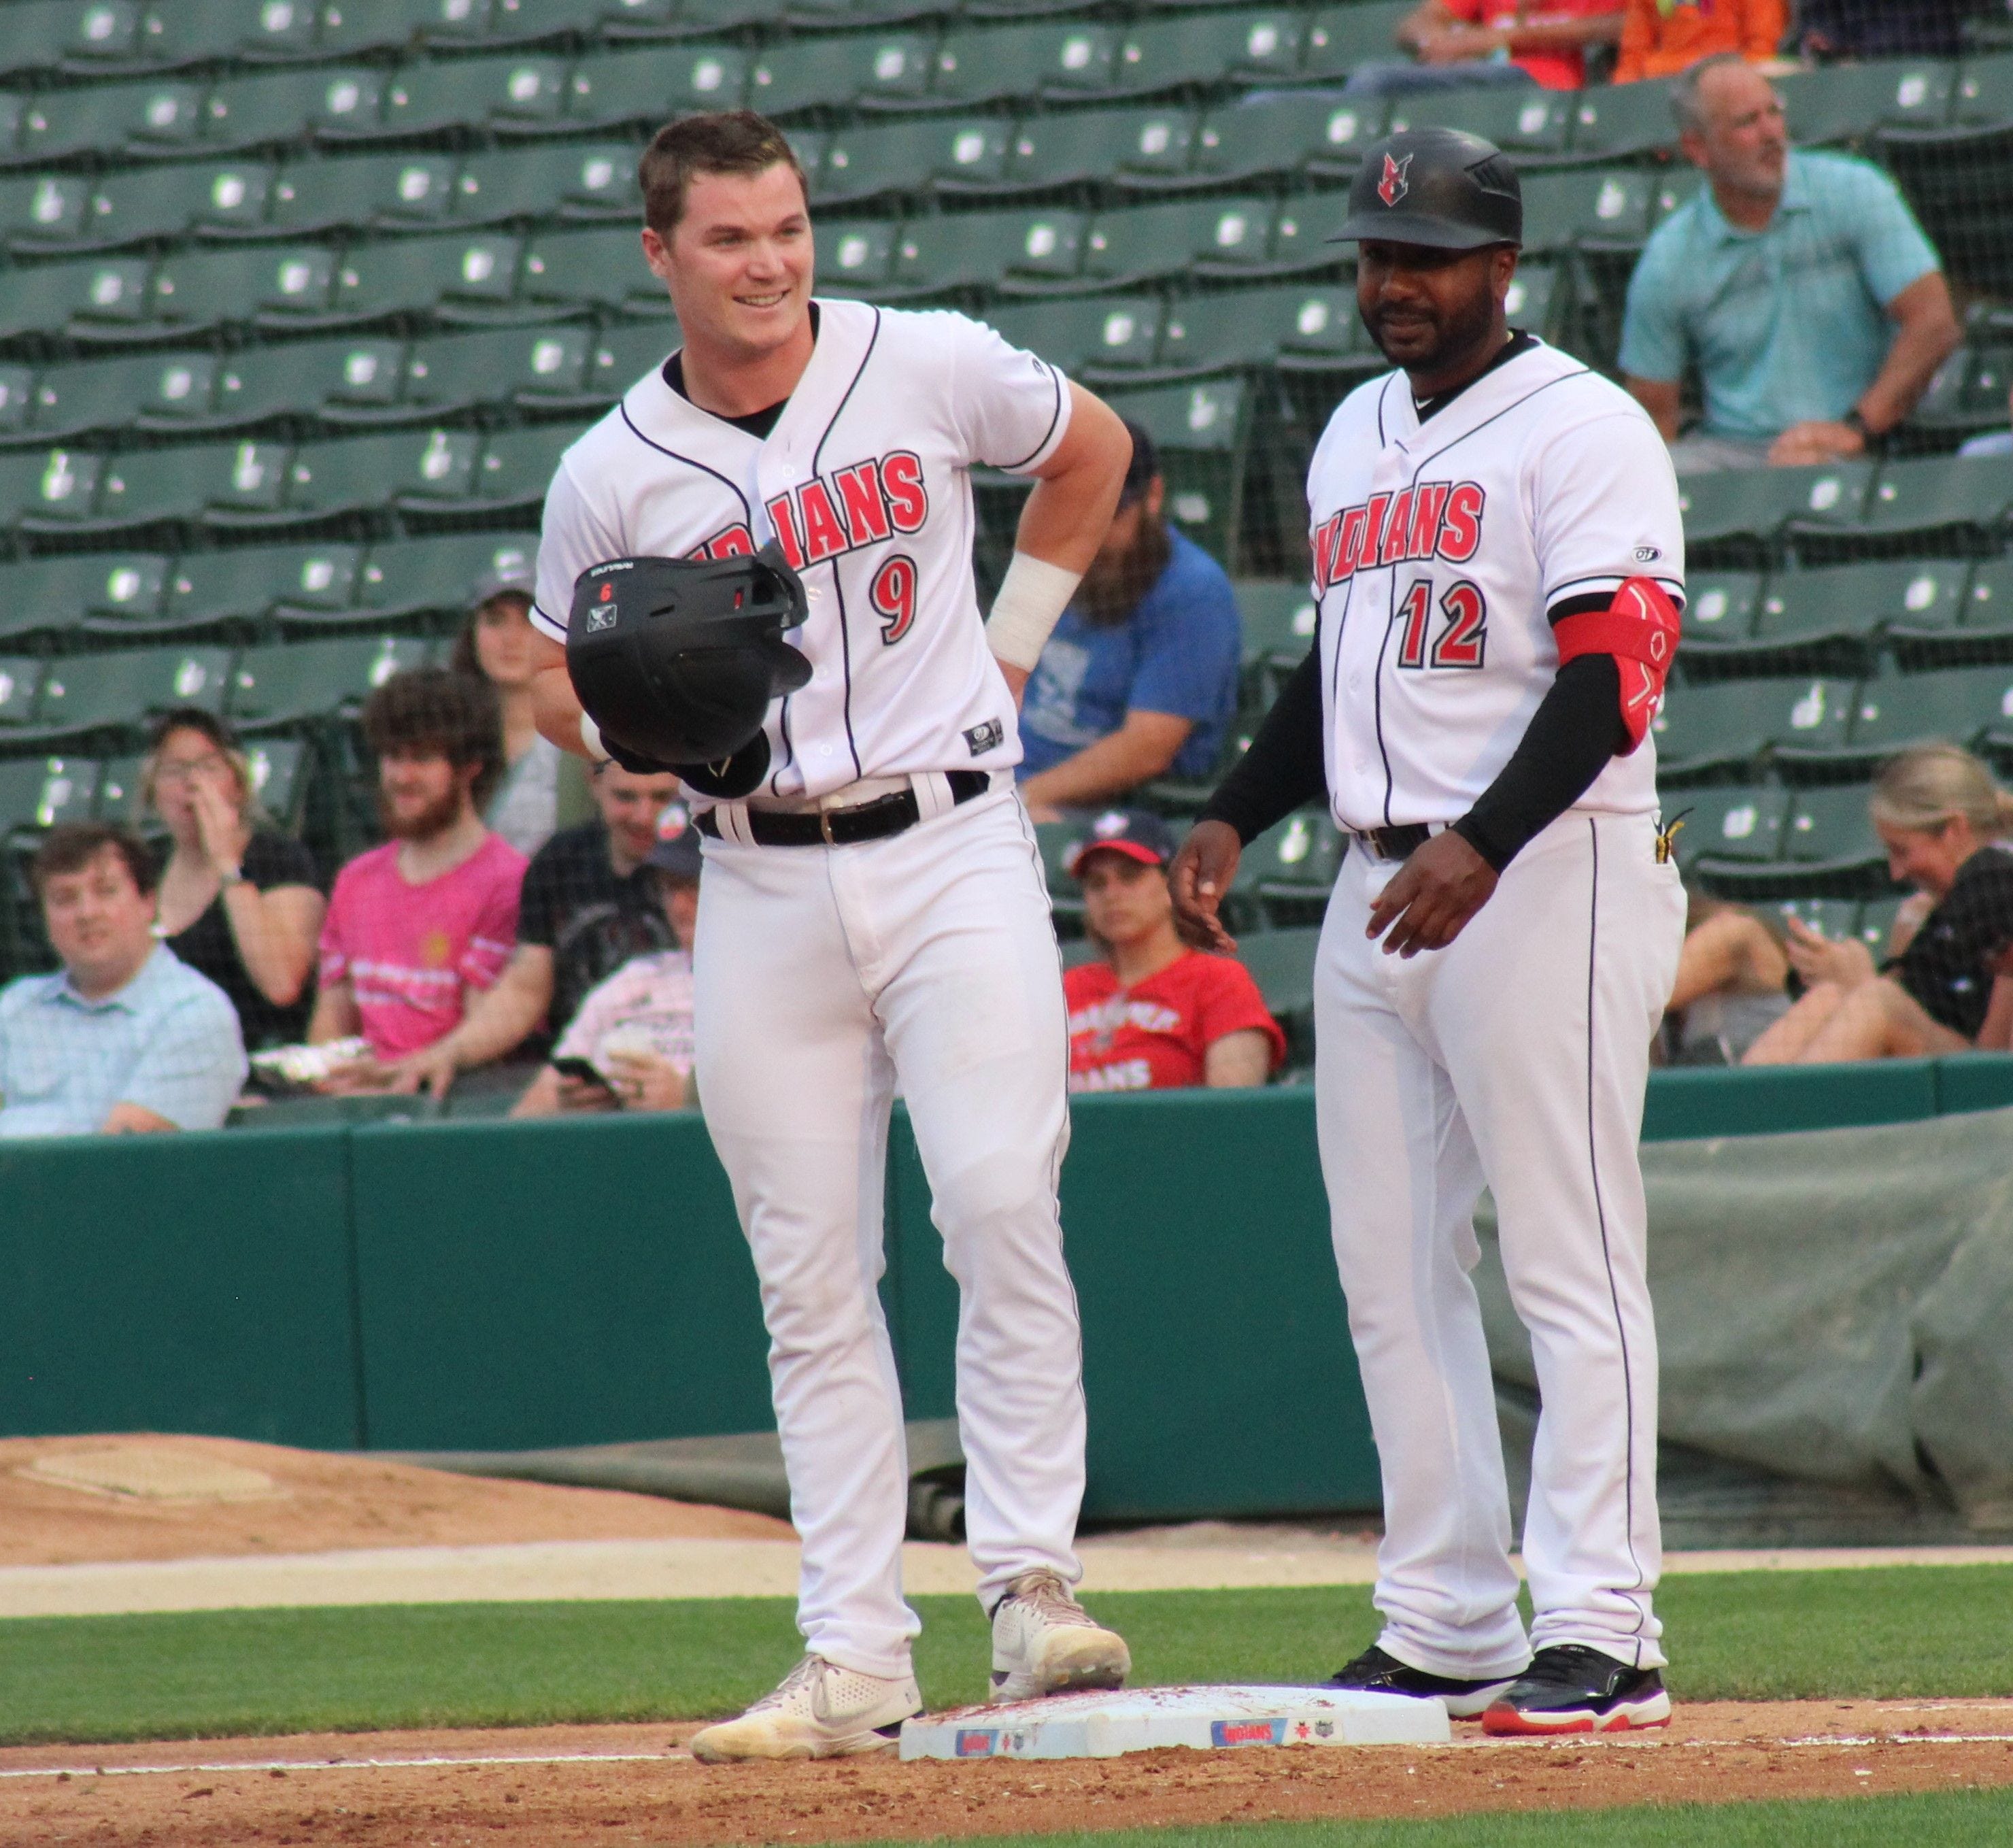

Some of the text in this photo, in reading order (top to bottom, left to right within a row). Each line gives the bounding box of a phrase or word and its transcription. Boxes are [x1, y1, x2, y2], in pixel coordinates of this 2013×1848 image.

[681, 450, 928, 573] IANS
[1309, 480, 1486, 597] NDIANS
[868, 554, 918, 645] 9
[1395, 578, 1487, 669] 12
